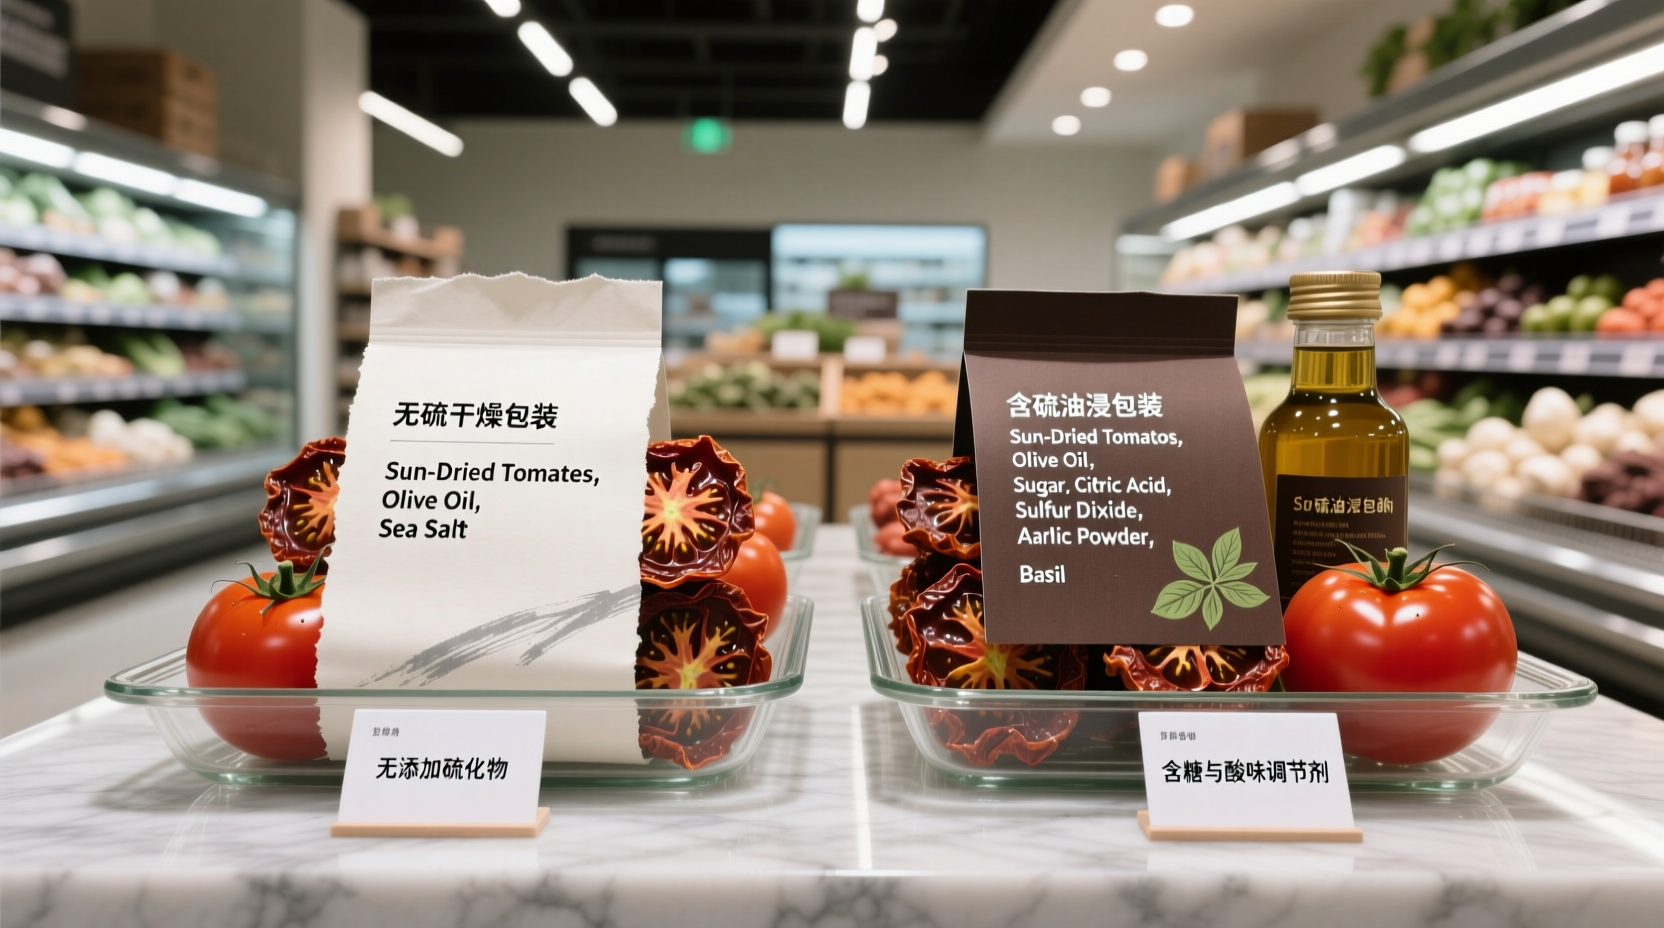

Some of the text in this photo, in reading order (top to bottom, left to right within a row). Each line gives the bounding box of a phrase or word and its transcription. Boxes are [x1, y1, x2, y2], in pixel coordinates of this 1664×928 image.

[392, 401, 559, 430] 无硫干燥包装
[1006, 391, 1164, 419] 含硫油浸包装
[1009, 427, 1184, 448] Sun-Dried Tomatos,
[1012, 451, 1096, 471] Olive Oil,
[384, 461, 601, 487] Sun-Dried Tomates,
[1013, 476, 1172, 498] Sugar, Citric Acid,
[382, 489, 482, 514] Olive Oil,
[1015, 499, 1143, 522] Sulfur Dixide,
[378, 518, 469, 539] Sea Salt
[1017, 526, 1155, 549] Aarlic Powder,
[1019, 564, 1066, 584] Basil
[375, 756, 509, 781] 无添加硫化物
[1162, 758, 1330, 784] 含糖与酸味调节剂
